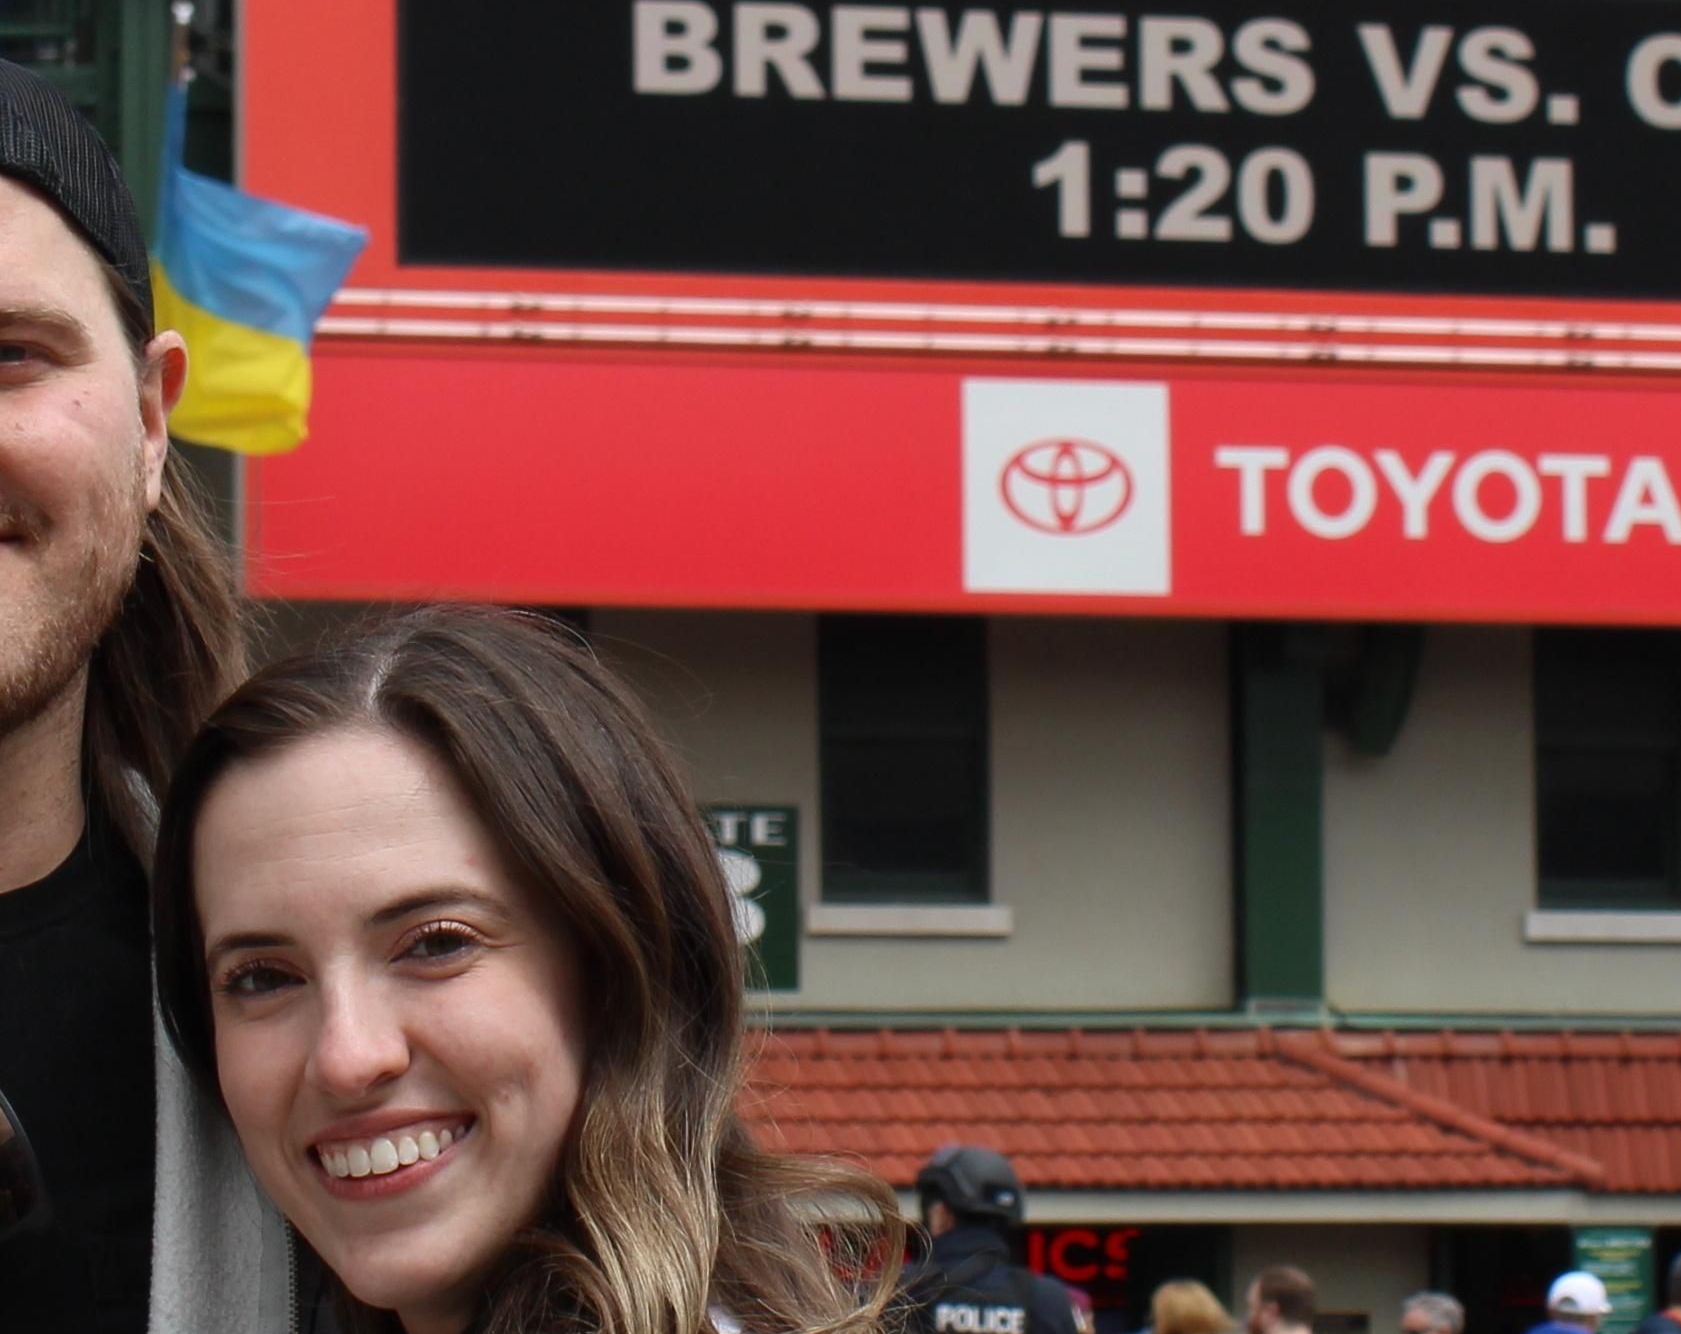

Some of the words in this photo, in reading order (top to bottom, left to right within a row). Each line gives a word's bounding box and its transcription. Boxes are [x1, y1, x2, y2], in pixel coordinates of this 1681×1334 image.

[1358, 23, 1579, 125] VS.
[1033, 142, 1315, 245] 1:20
[1364, 151, 1617, 254] P.M.
[712, 809, 788, 847] TE
